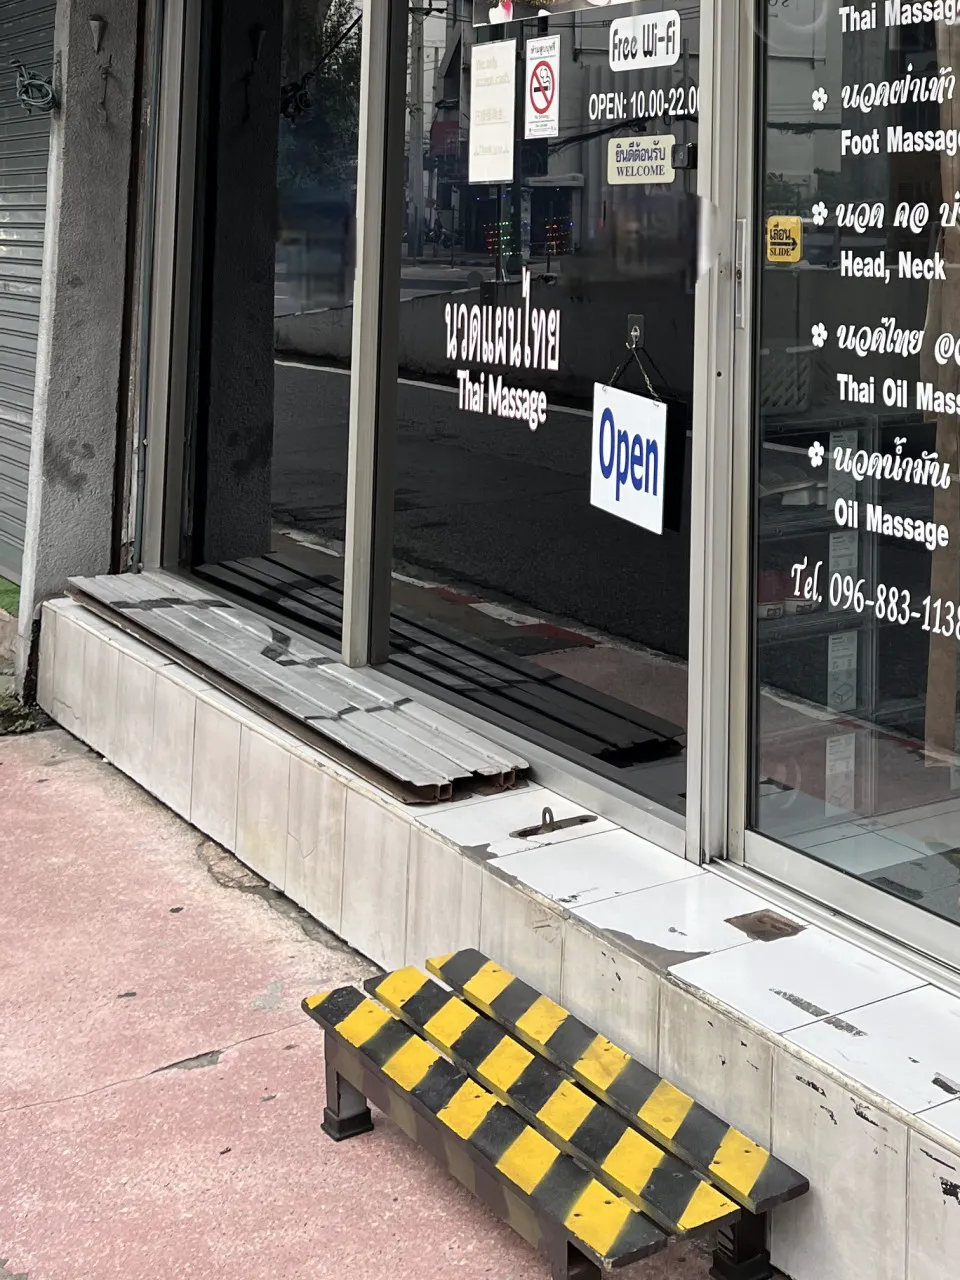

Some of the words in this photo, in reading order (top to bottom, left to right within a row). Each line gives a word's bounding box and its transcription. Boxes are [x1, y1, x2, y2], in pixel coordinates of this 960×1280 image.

[838, 1, 877, 33] Thai
[841, 63, 957, 113] นวดฝ่าเท้า
[589, 91, 627, 121] OPEN:
[615, 140, 666, 163] ยินดีต้อนรับ
[841, 129, 880, 156] Foot
[616, 164, 666, 177] WELCOME
[769, 221, 792, 241] เลื่อน
[835, 203, 886, 233] นวด
[893, 201, 929, 234] คอ
[769, 247, 792, 257] SLIDE
[840, 250, 890, 284] Head,
[898, 251, 947, 280] Neck
[445, 266, 561, 371] นวดแผนไทย
[836, 317, 924, 357] นวดไทย
[456, 369, 485, 413] Thai
[488, 373, 548, 431] Massage
[836, 373, 875, 404] Thai
[882, 377, 908, 408] Oil
[599, 407, 659, 502] Open
[833, 436, 951, 489] นวดน้ำมัน
[834, 497, 858, 529] Oil
[866, 503, 949, 551] Massage
[791, 556, 823, 603] Tel.
